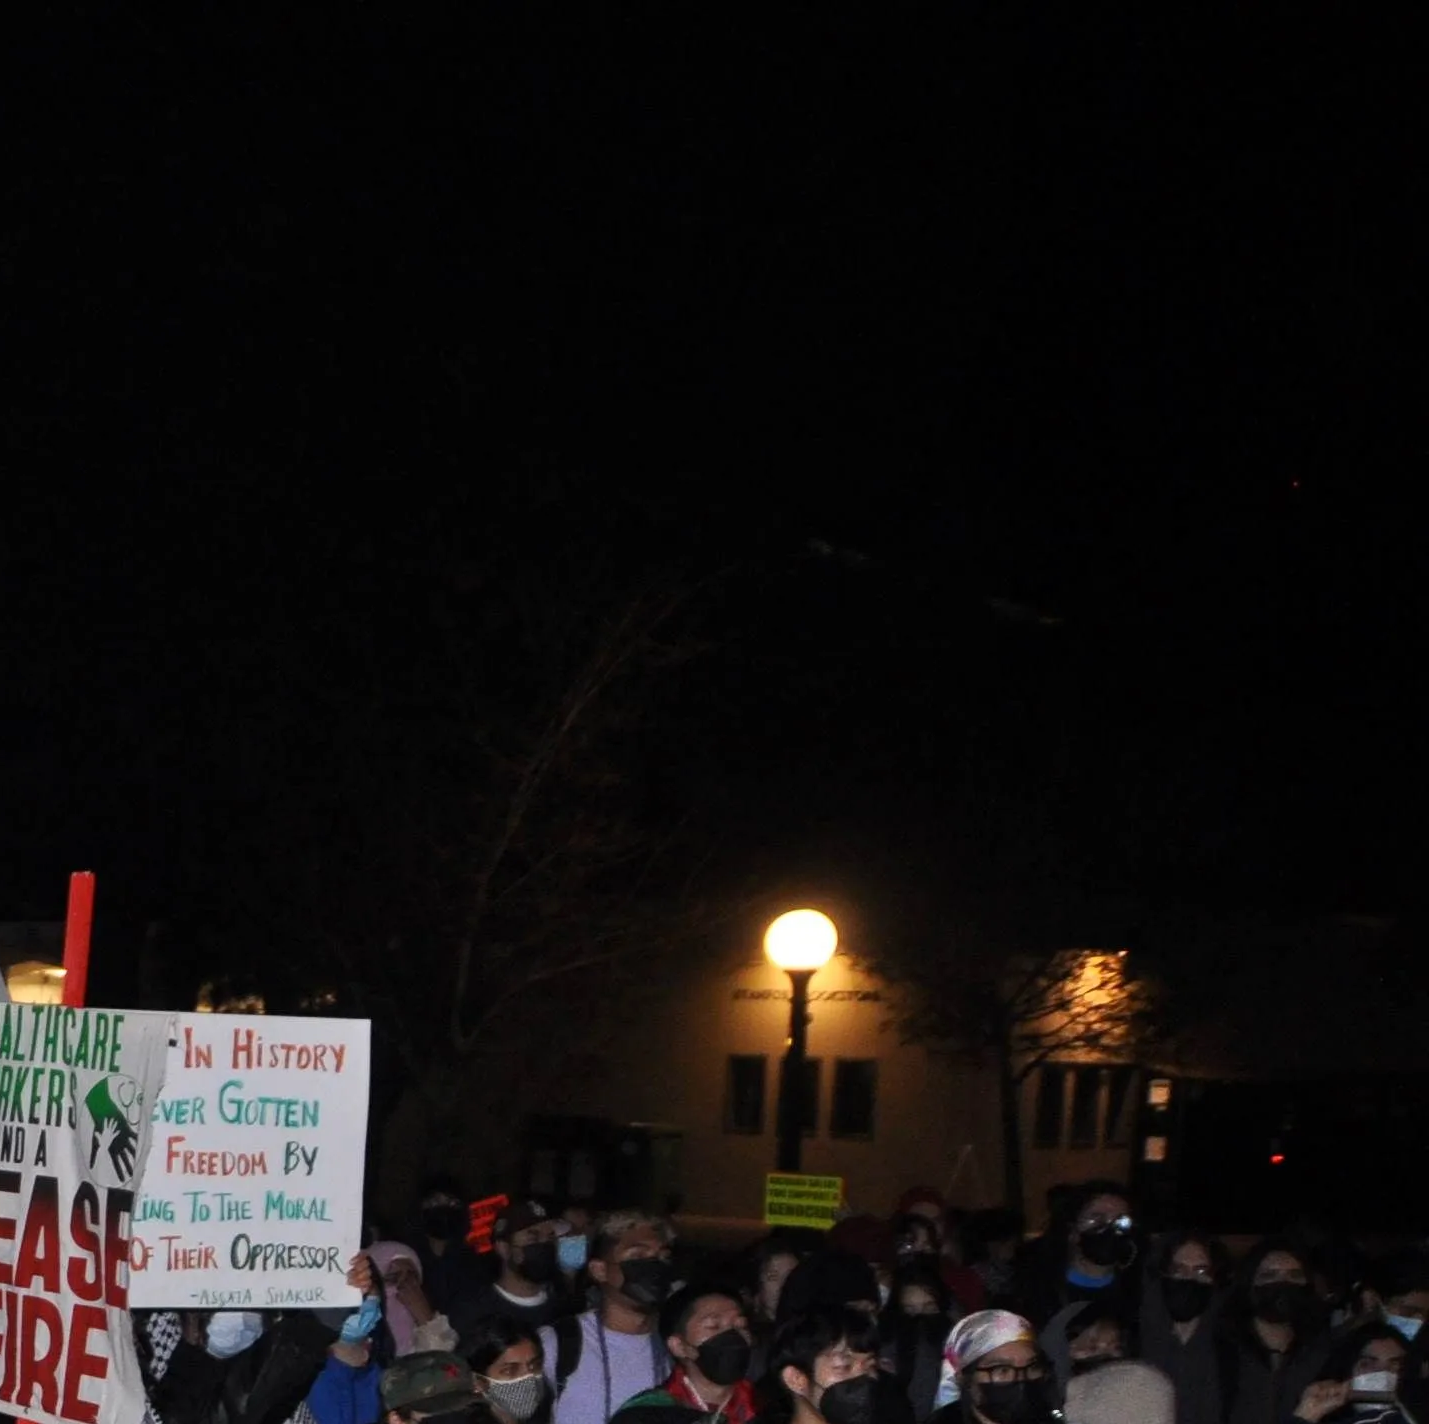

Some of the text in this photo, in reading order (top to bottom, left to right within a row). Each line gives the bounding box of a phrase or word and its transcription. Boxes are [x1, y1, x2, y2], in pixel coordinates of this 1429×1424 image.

[184, 1026, 212, 1069] IN
[218, 1080, 320, 1128] GOTTEN
[34, 1130, 47, 1167] A
[166, 1136, 318, 1176] FREEDOM BY
[183, 1191, 211, 1222] TO
[216, 1192, 253, 1221] THE
[264, 1190, 333, 1222] MORAL
[129, 1237, 154, 1271] OF
[230, 1233, 345, 1274] OPPRESSOR
[265, 1286, 326, 1305] SHAKUR
